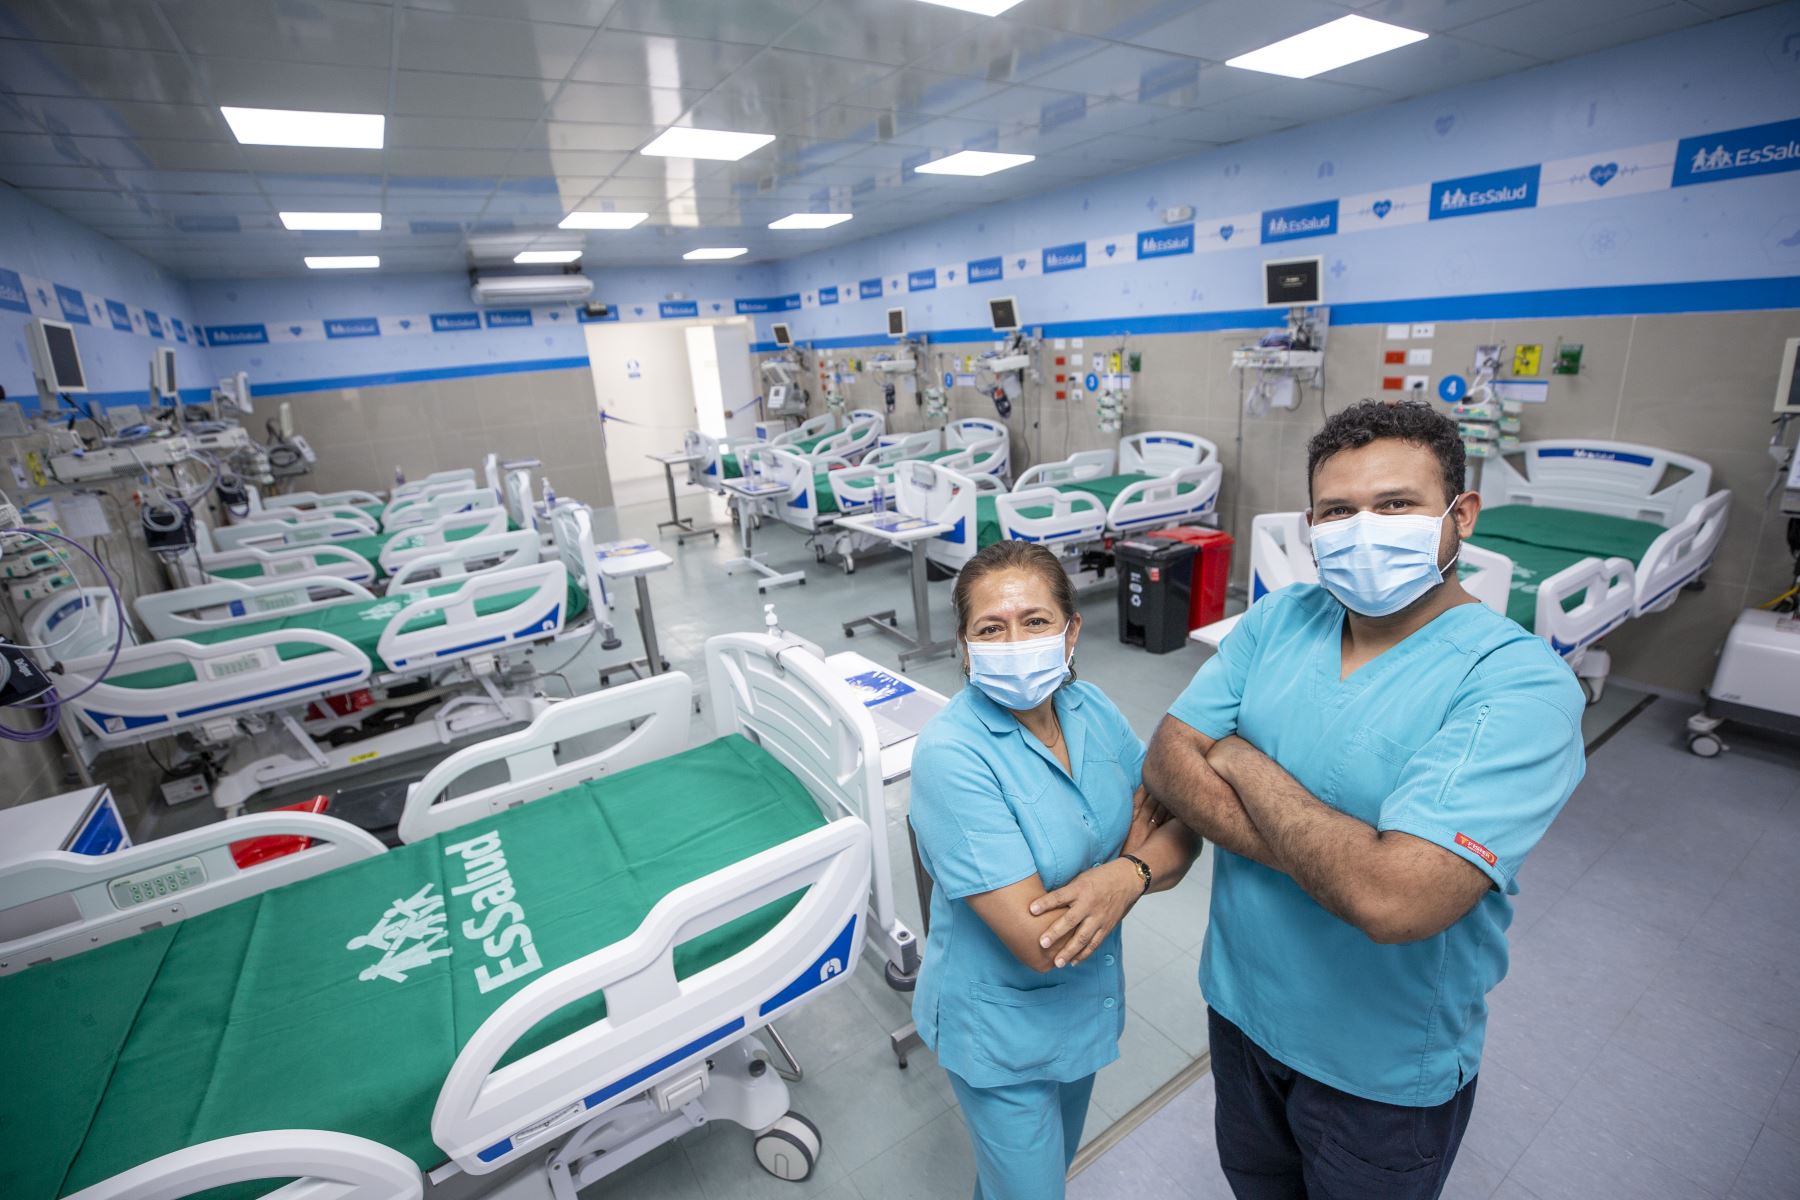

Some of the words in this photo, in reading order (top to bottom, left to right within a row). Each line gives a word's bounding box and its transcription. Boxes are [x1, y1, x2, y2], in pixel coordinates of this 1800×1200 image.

[1469, 183, 1527, 206] EsSalud
[1289, 214, 1330, 233] EsSalud
[1447, 380, 1456, 396] 4
[444, 829, 544, 995] EsSalud
